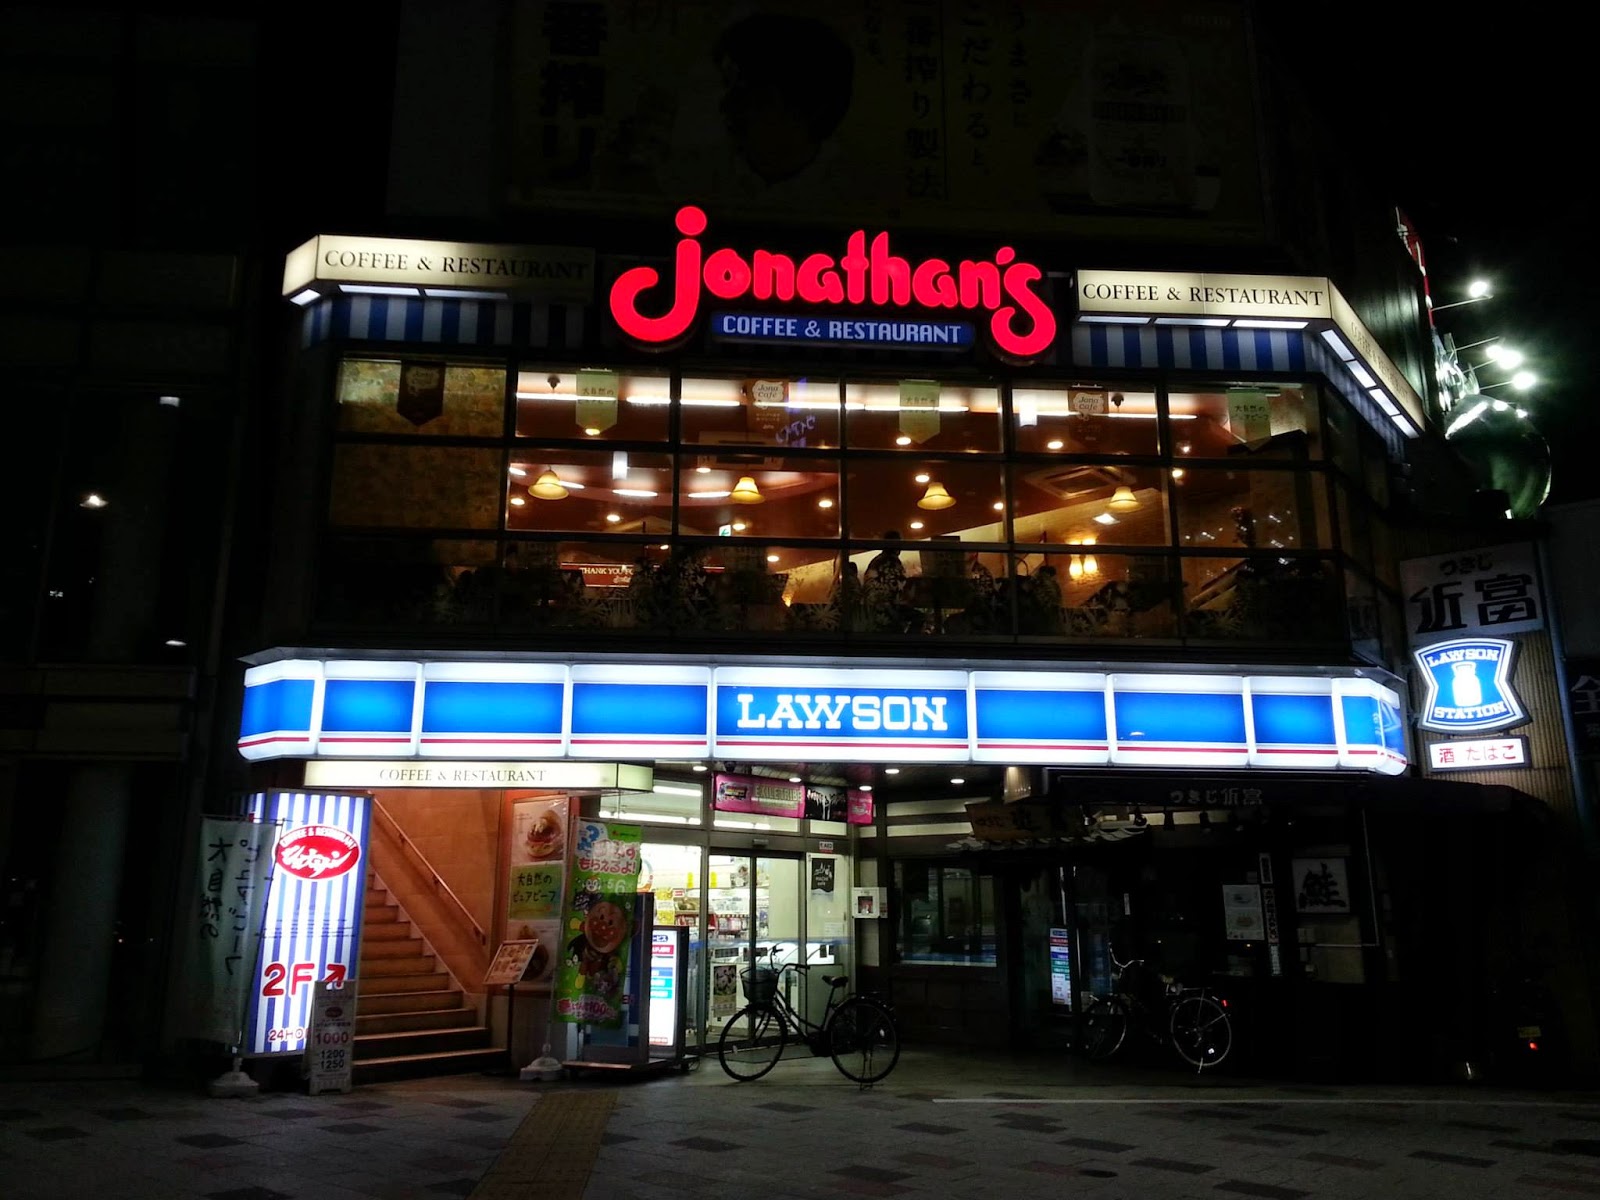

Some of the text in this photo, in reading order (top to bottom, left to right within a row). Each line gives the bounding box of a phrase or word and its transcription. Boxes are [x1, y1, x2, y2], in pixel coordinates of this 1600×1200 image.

[325, 249, 586, 281] COFFEE & RESTAURANT
[1082, 283, 1323, 306] COFFEE & RESTAURANT
[722, 315, 962, 344] COFFEE & RESTAURANT
[1440, 554, 1494, 575] つきじ
[1410, 574, 1537, 633] 近富
[1427, 648, 1500, 668] LAWSON
[737, 693, 948, 731] LAWSON
[1433, 701, 1507, 720] STATION
[1439, 748, 1455, 763] 酒
[379, 768, 432, 782] COFFEE
[453, 769, 547, 782] RESTAURANT
[262, 963, 315, 997] 2F
